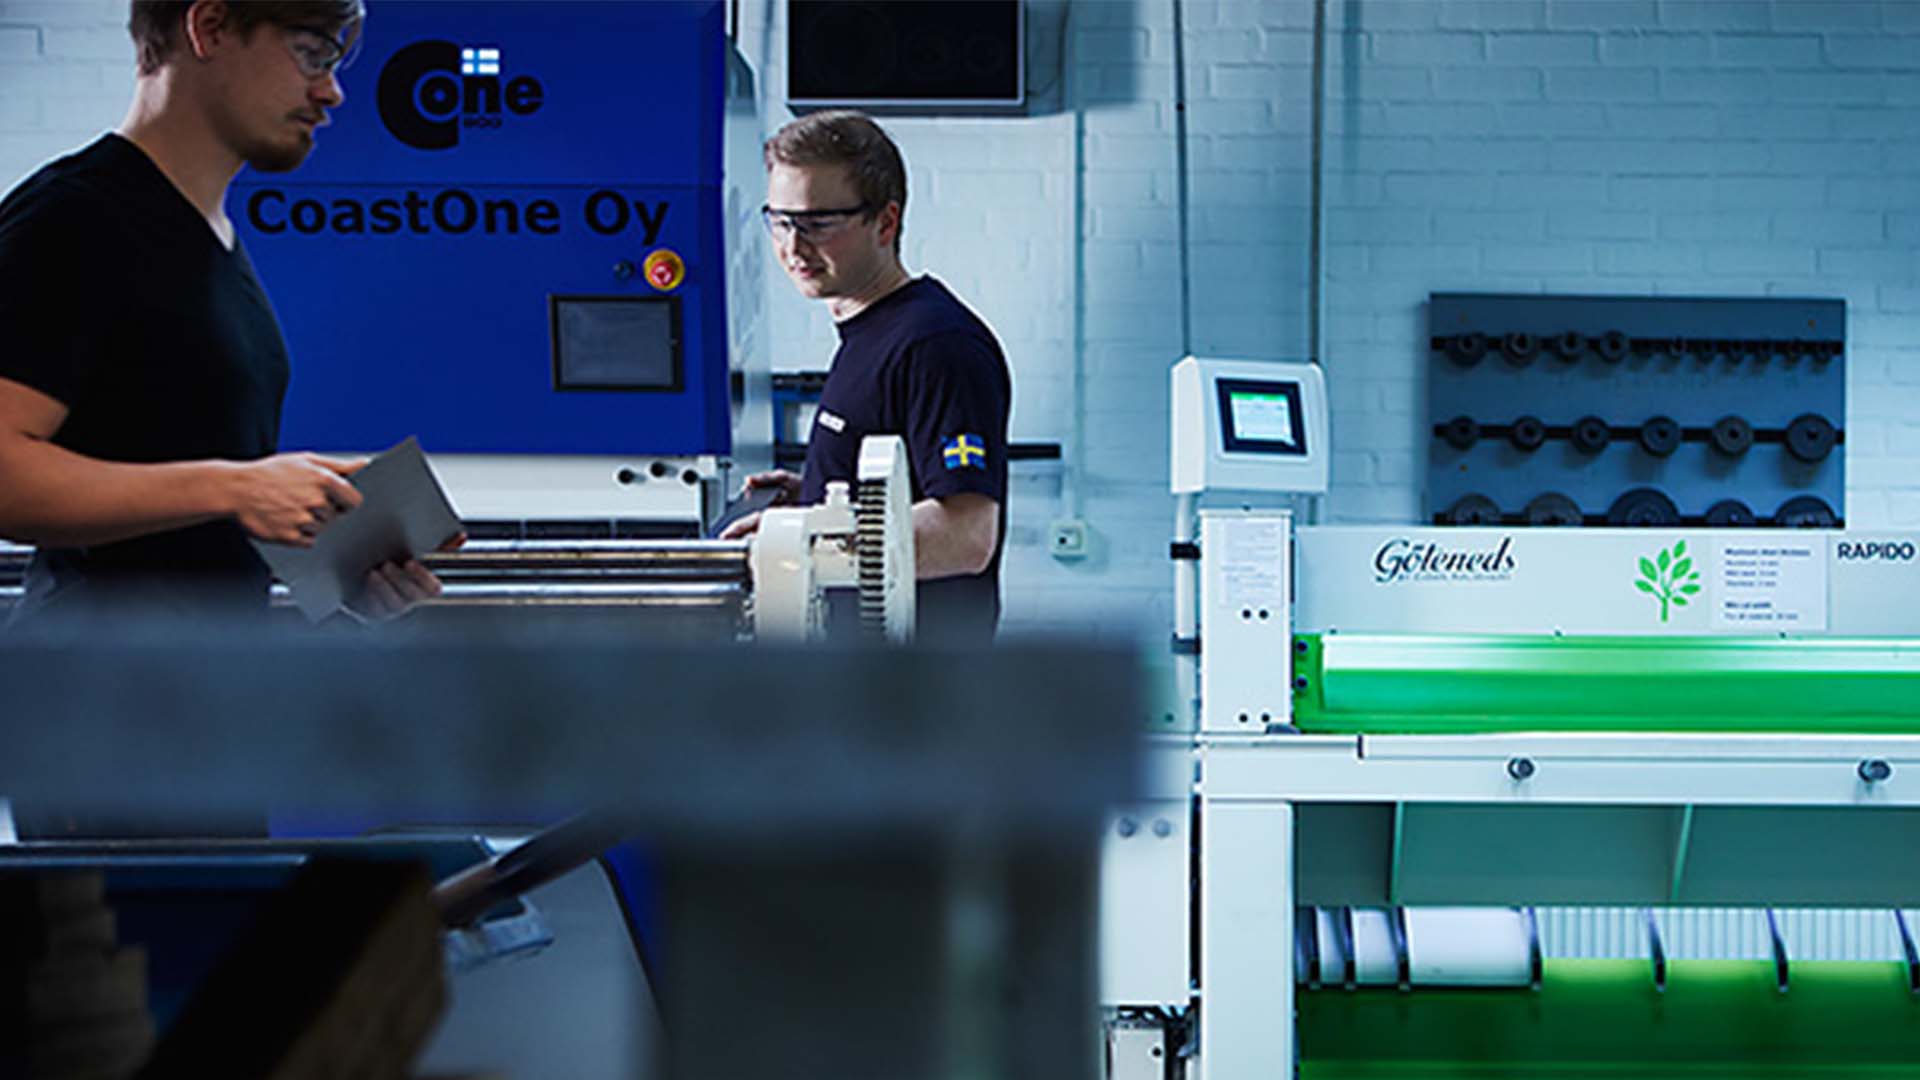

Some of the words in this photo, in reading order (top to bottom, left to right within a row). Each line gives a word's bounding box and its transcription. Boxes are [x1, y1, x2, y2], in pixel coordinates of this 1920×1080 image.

[247, 189, 560, 235] CoastOne
[583, 190, 669, 245] Oy
[1837, 541, 1915, 561] RAPIDO
